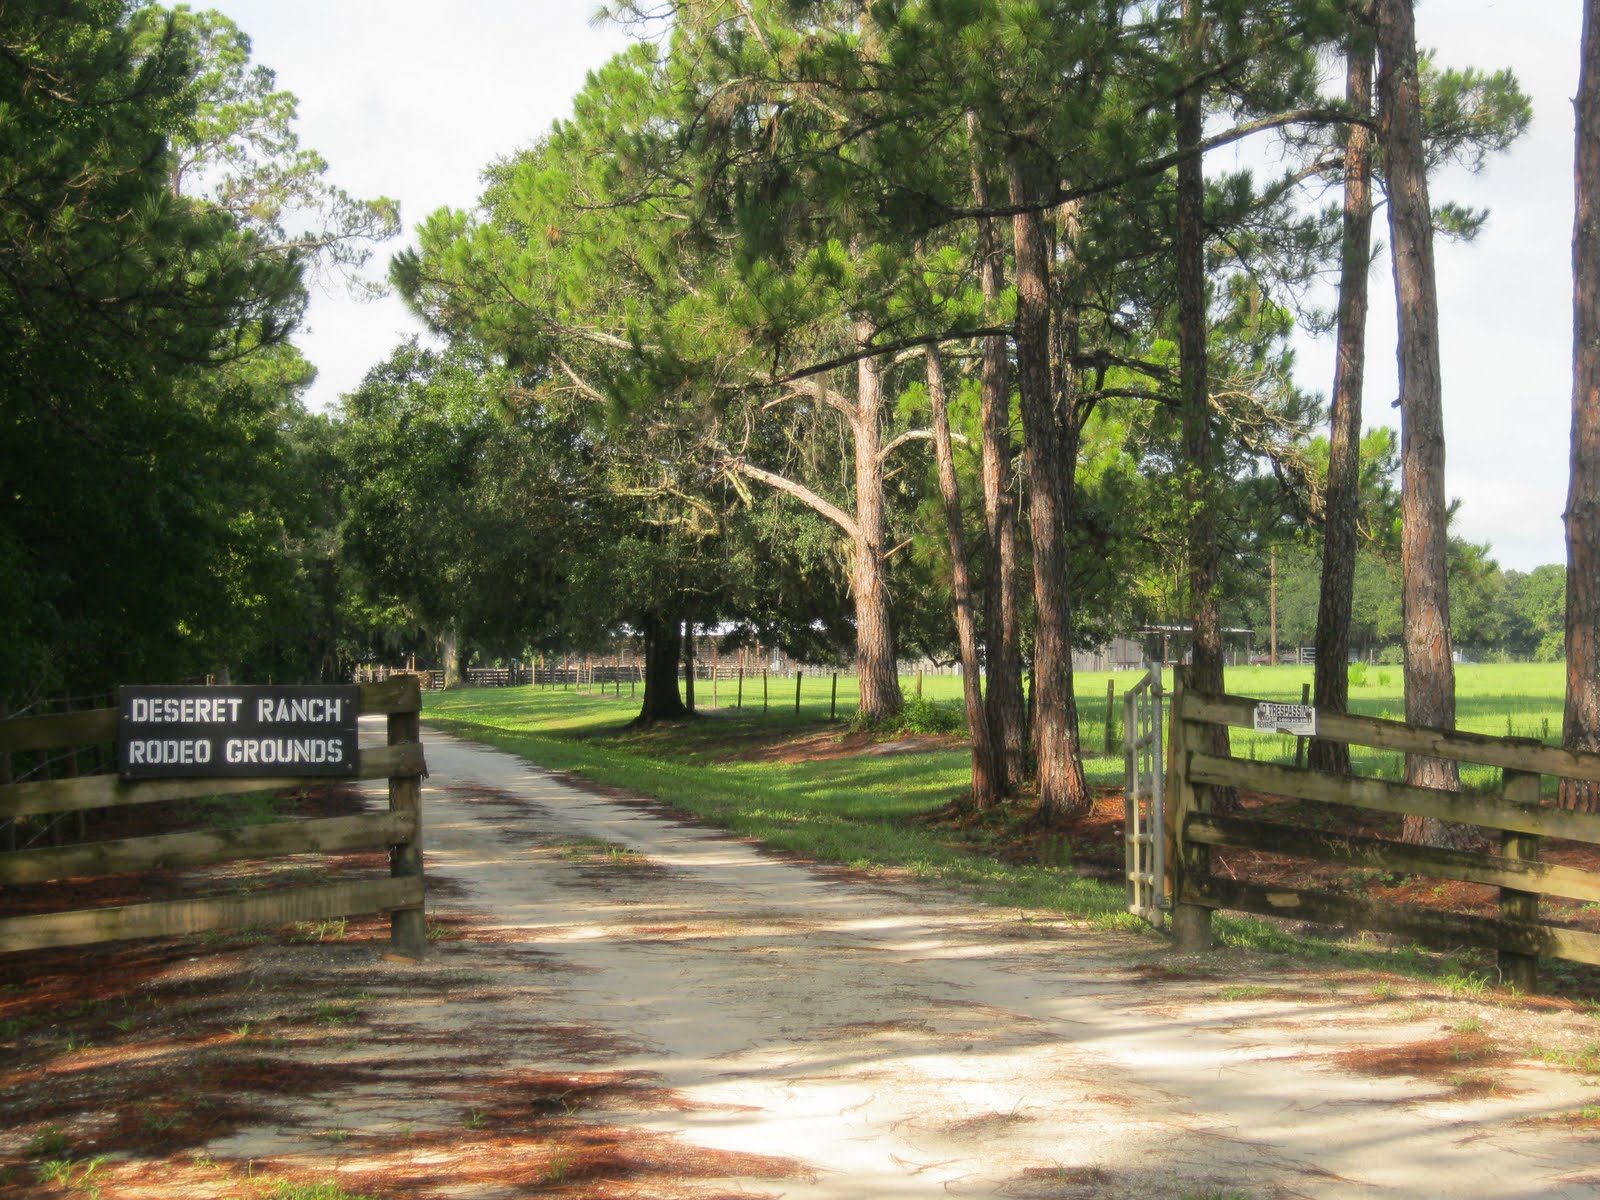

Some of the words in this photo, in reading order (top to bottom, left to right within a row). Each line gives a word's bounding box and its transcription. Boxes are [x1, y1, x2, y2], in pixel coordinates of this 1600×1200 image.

[132, 698, 242, 722] DESERET
[258, 698, 341, 722] RANCH
[129, 740, 211, 764] RODEO
[226, 739, 343, 763] GROUNDS
